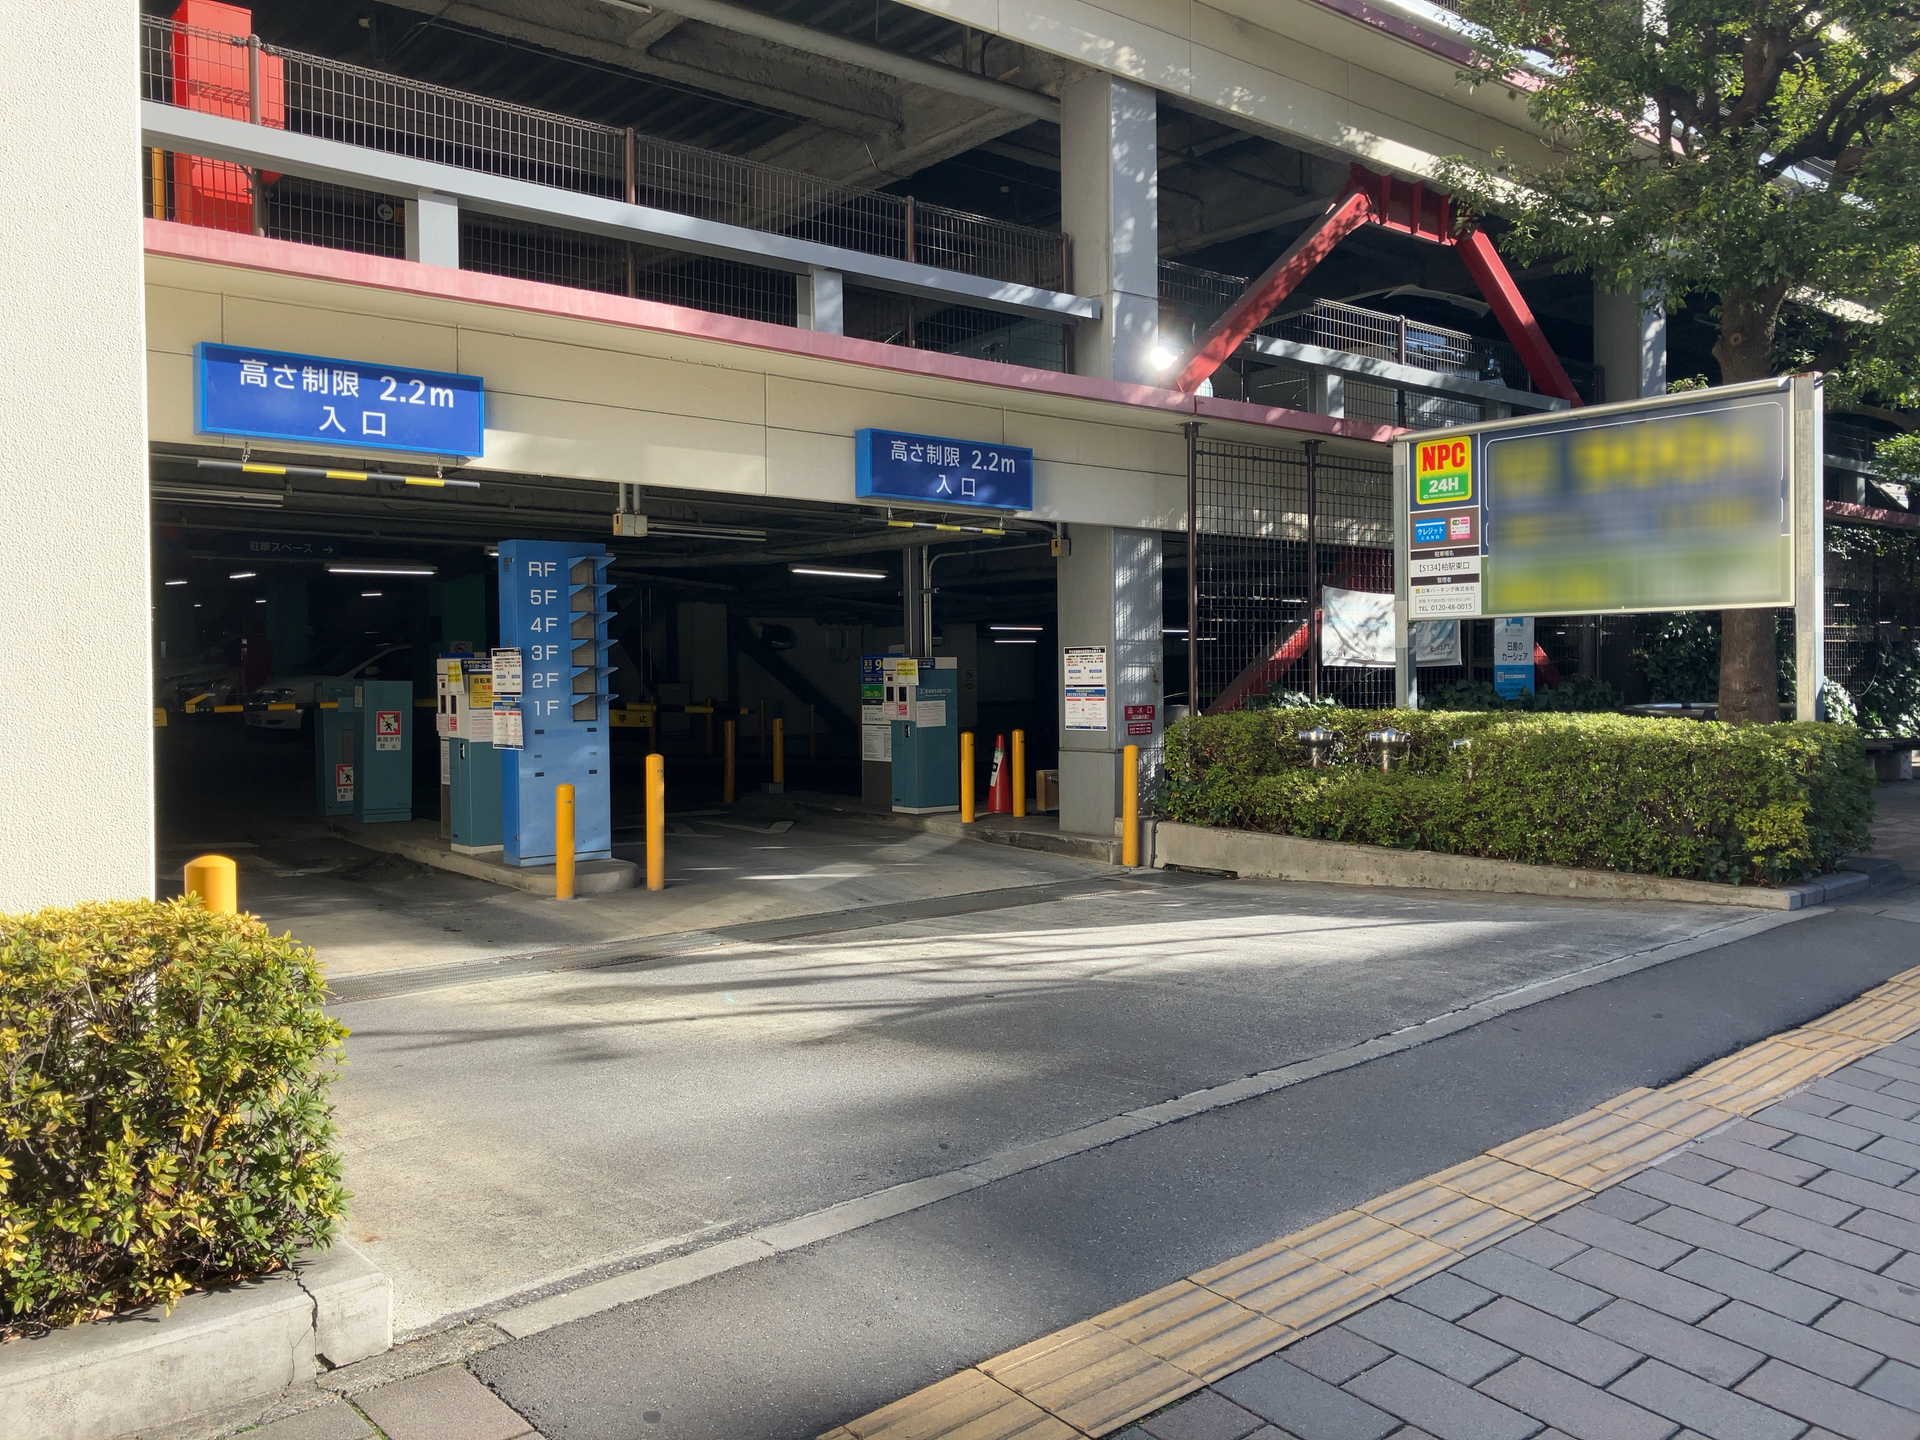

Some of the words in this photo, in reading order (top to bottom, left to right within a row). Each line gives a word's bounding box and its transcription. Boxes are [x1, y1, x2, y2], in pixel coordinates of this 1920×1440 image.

[239, 358, 360, 398] 高さ制限
[379, 375, 455, 408] 2.2m
[319, 405, 387, 437] 入口
[890, 440, 960, 468] 高さ制限
[971, 449, 1016, 474] 2.2m
[1422, 441, 1465, 472] NPC
[936, 474, 976, 497] 入口
[1429, 477, 1459, 493] 24H
[528, 561, 557, 577] RF
[530, 589, 558, 605] 5F
[530, 617, 558, 633] 4F
[531, 645, 559, 661] 3F
[532, 672, 559, 689] 2F
[534, 700, 559, 716] 1F
